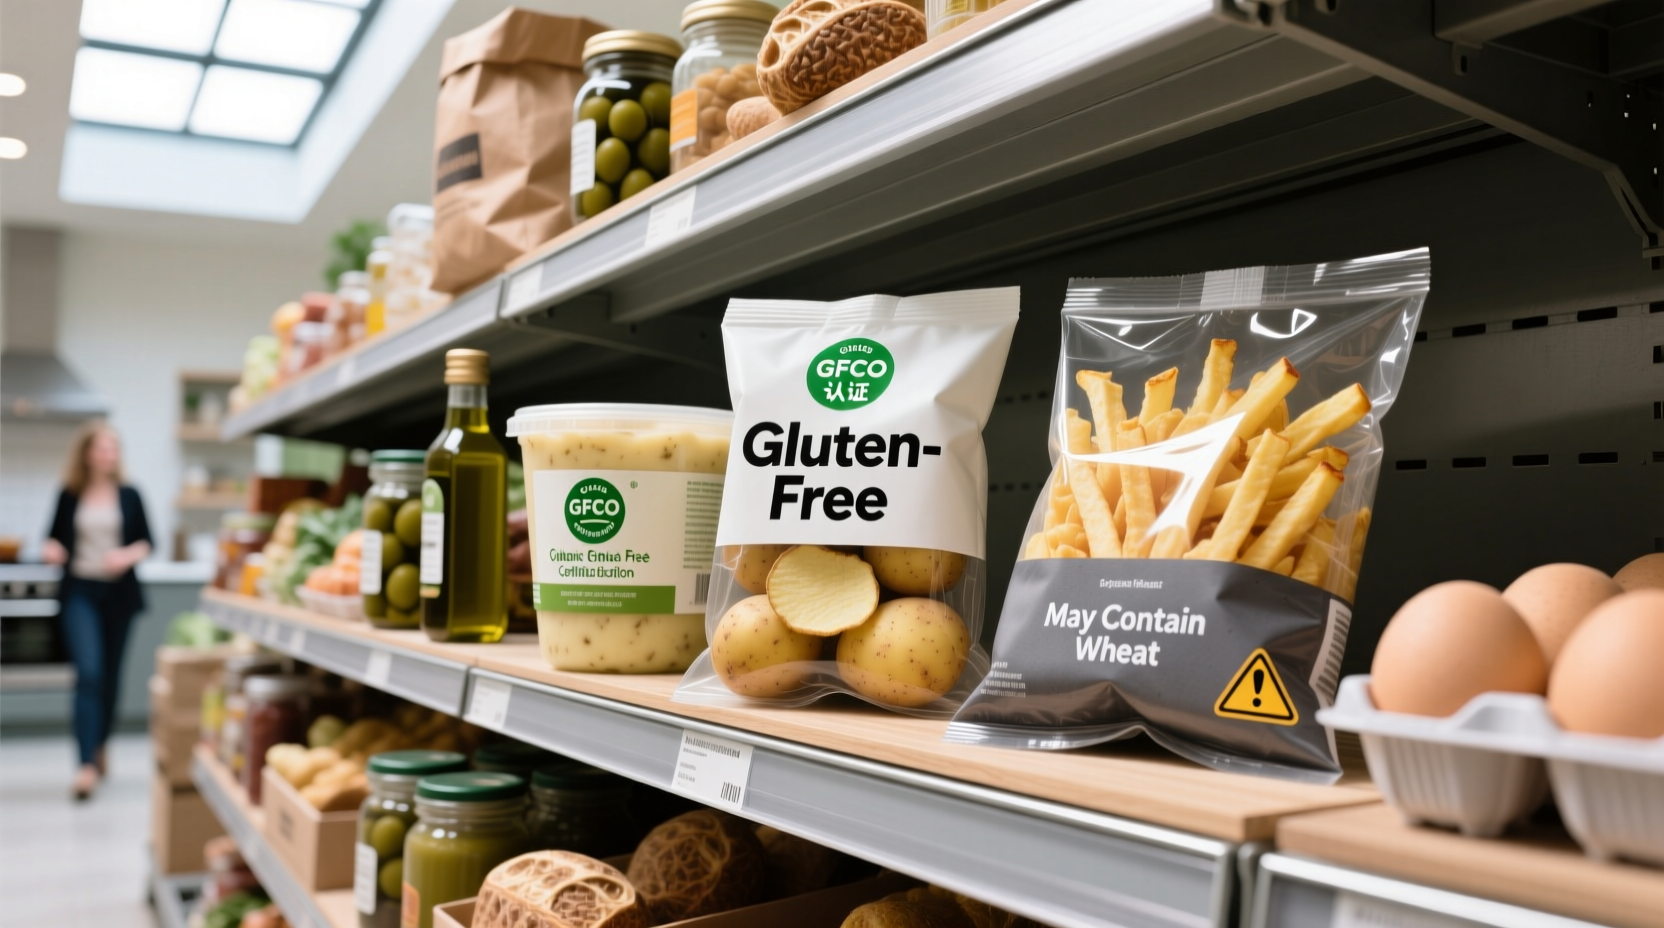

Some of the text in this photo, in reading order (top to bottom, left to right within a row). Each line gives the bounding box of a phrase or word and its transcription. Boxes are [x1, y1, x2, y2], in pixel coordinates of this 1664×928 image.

[816, 359, 888, 378] GFCO
[823, 381, 870, 402] 认证
[743, 421, 942, 468] Gluten-
[569, 498, 620, 517] GFCO
[769, 475, 888, 521] Free
[1044, 602, 1206, 636] May Contain
[1076, 635, 1161, 667] Wheat
